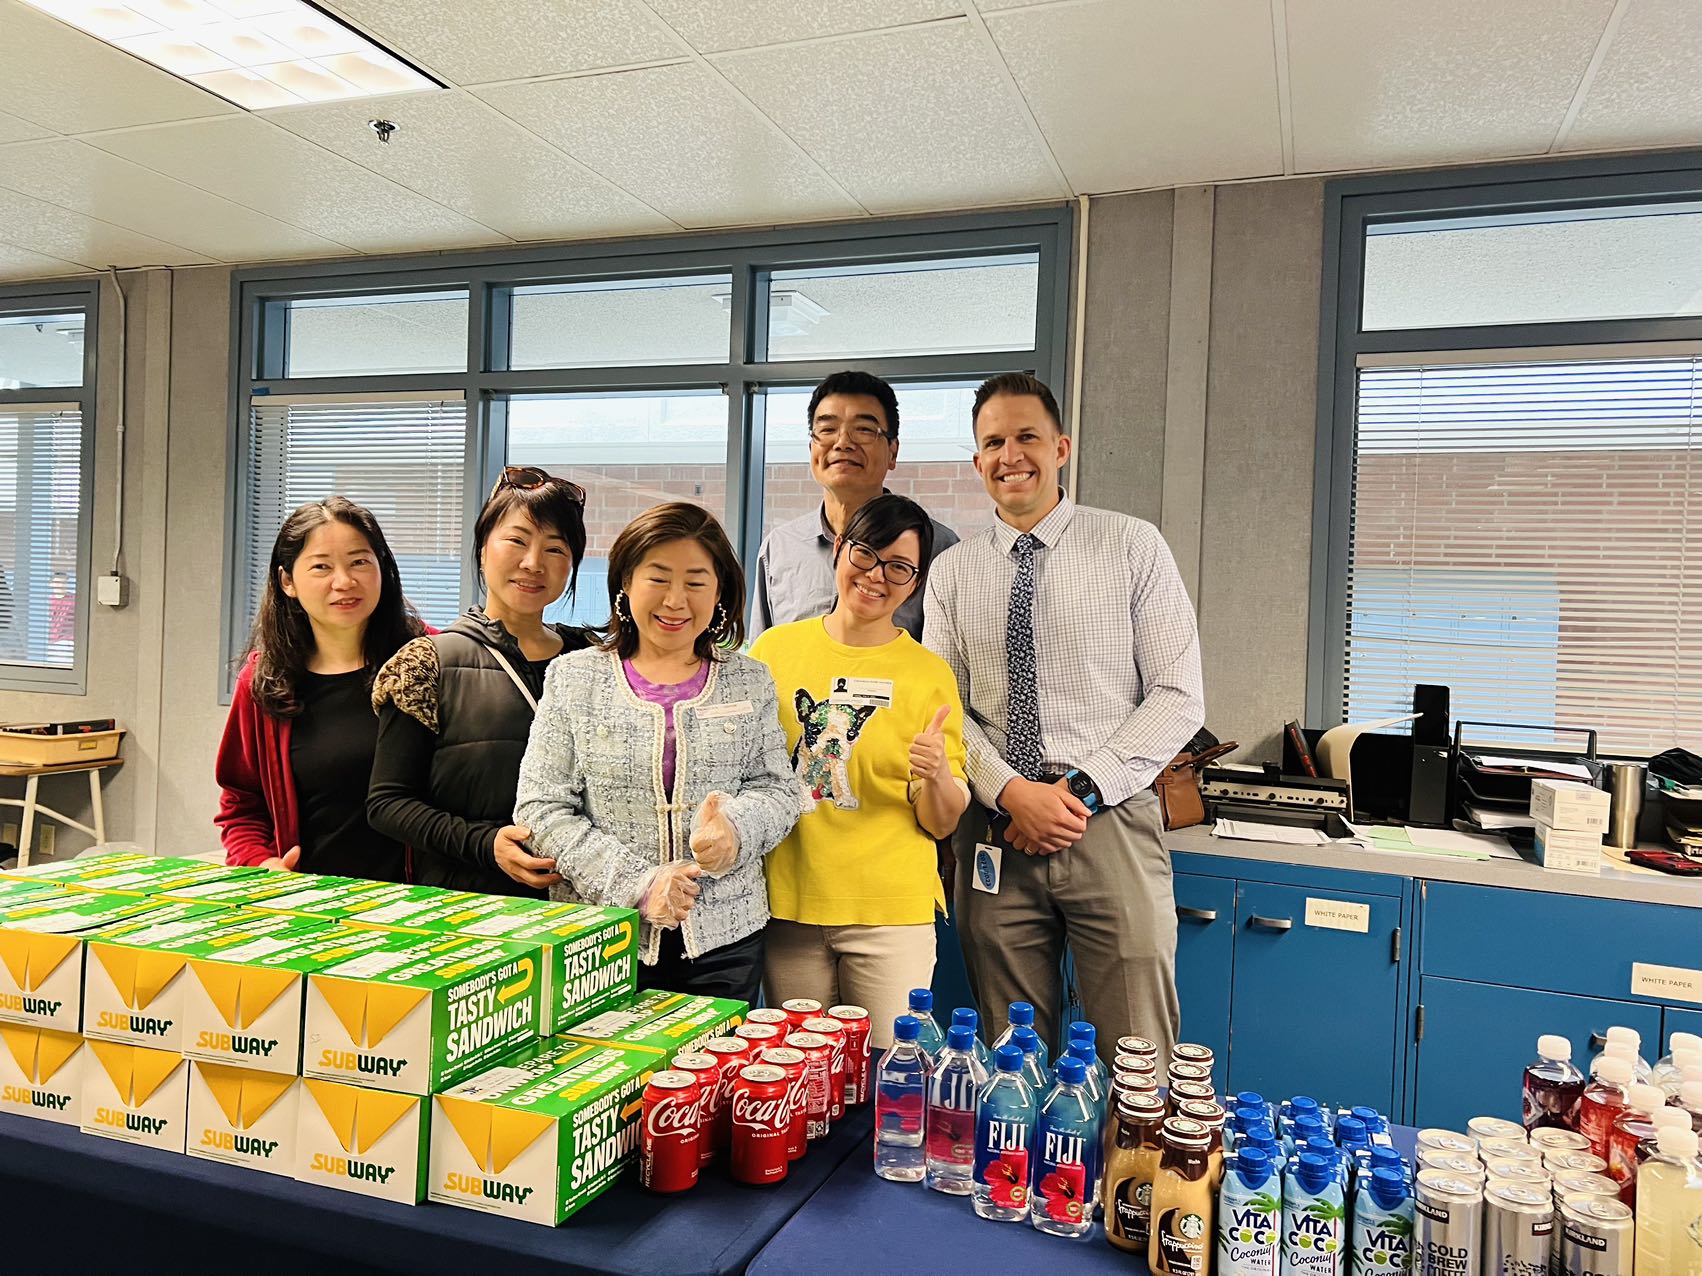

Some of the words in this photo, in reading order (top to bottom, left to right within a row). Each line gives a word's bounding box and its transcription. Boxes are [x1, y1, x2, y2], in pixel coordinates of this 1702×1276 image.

[1314, 910, 1336, 918] WHITE
[1338, 912, 1359, 920] PAPER
[563, 931, 602, 957] SOMEBODY'S
[602, 926, 614, 940] GOT
[614, 924, 620, 935] A
[563, 943, 602, 981] TASTY
[447, 970, 496, 1003] SOMEBODY'S
[497, 964, 512, 981] GOT
[512, 962, 518, 975] A
[562, 954, 631, 1009] SANDWICH
[1641, 976, 1666, 986] WHITE
[1669, 980, 1693, 989] PAPER
[447, 985, 497, 1031] TASTY
[624, 997, 715, 1041] GREATNESS
[97, 1012, 173, 1036] SUBWAY
[446, 995, 533, 1063] SANDWICH
[196, 1031, 278, 1057] SUBWAY
[558, 1041, 578, 1052] TO
[318, 1050, 408, 1077] SUBWAY
[511, 1048, 626, 1106] GREATNESS
[558, 1060, 632, 1102] SUBWAY
[2, 1085, 72, 1110] SUBWAY
[572, 1088, 620, 1128] SOMEBODY'S
[620, 1079, 635, 1099] GOT
[634, 1076, 641, 1090] A
[94, 1108, 168, 1135] SUBWAY
[572, 1104, 620, 1157] TASTY
[200, 1129, 278, 1158] SUBWAY
[986, 1120, 1026, 1152] FIJI
[1044, 1131, 1082, 1166] FIJI
[570, 1117, 642, 1190] SANDWIC
[310, 1152, 396, 1184] SUBWAY
[444, 1172, 534, 1204] SUBWAY
[1232, 1208, 1272, 1230] VITA
[1292, 1214, 1332, 1237] VITA
[1228, 1227, 1276, 1244] COCO
[1288, 1231, 1337, 1252] COCO
[1366, 1229, 1408, 1253] VITA
[1230, 1243, 1272, 1262] Coconut
[1250, 1258, 1271, 1266] WATER
[1290, 1251, 1332, 1266] Coconut
[1362, 1248, 1412, 1269] COCO
[1428, 1242, 1468, 1258] COLD
[1428, 1253, 1468, 1270] BREW
[1310, 1264, 1332, 1274] WATER
